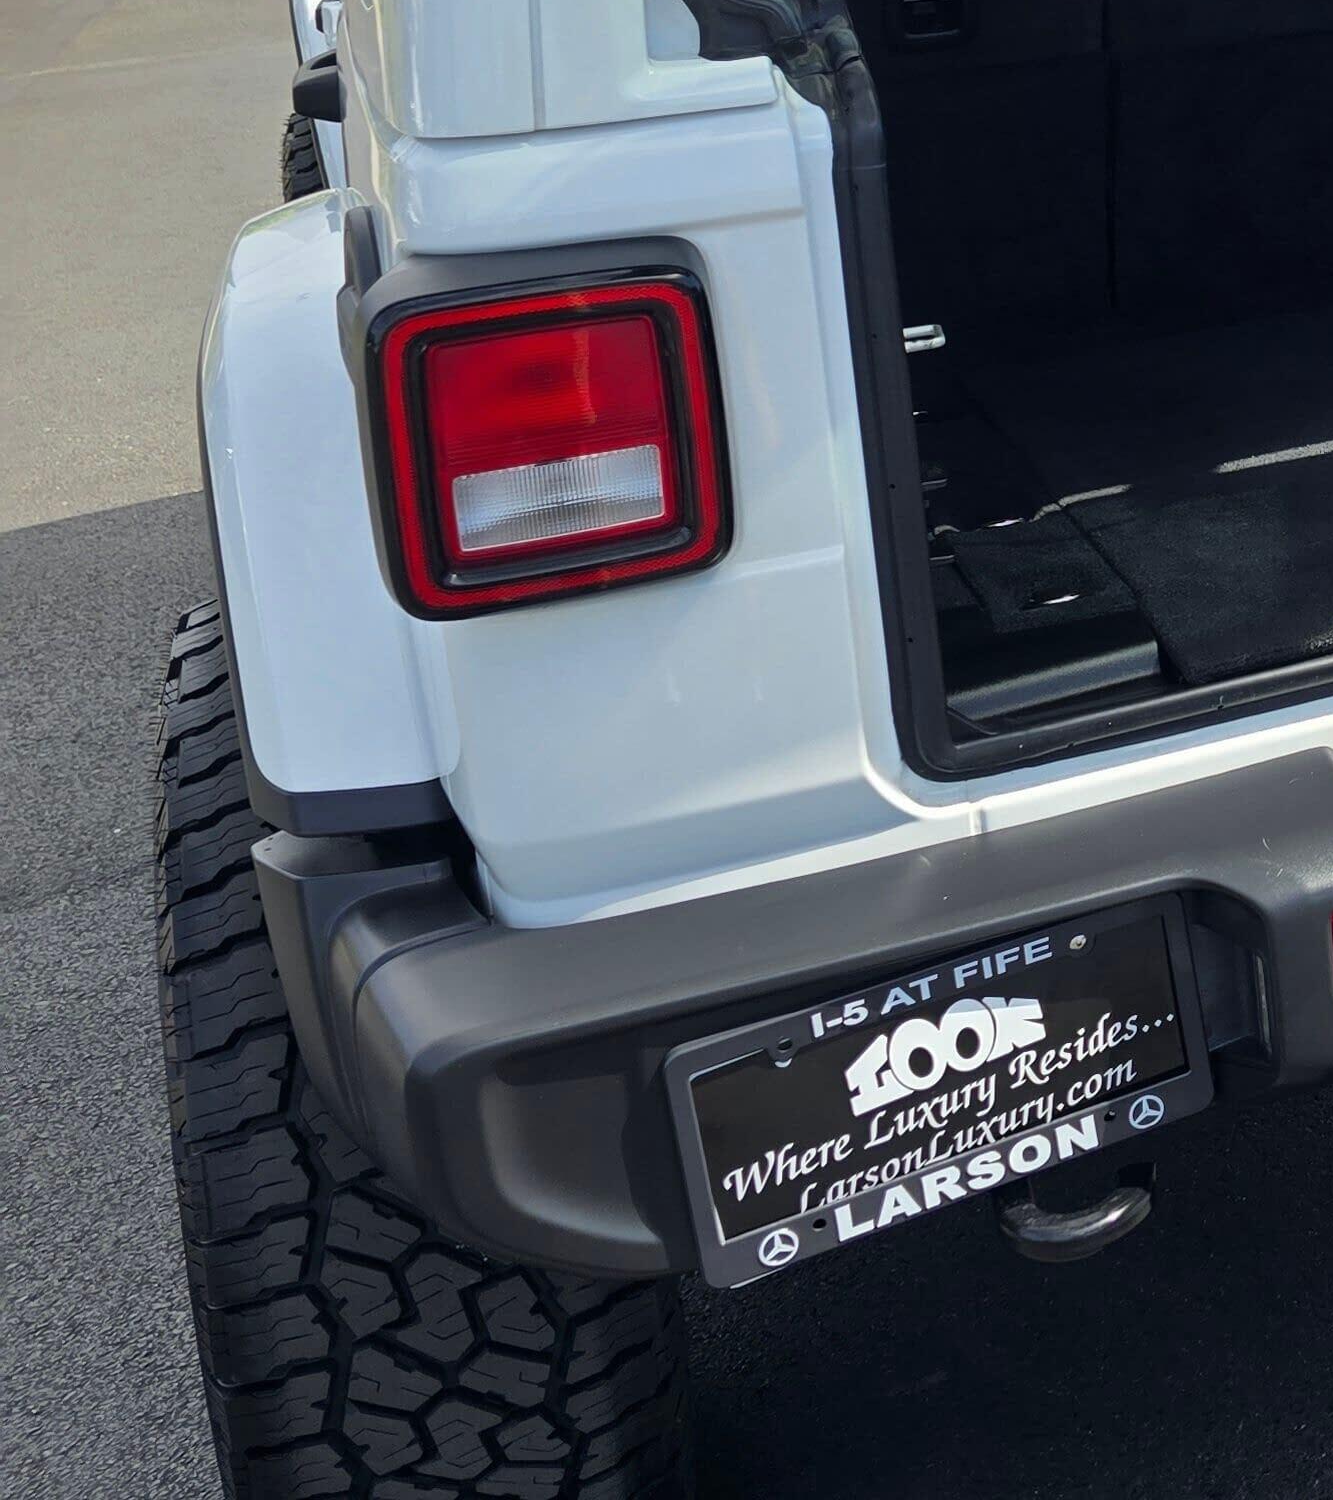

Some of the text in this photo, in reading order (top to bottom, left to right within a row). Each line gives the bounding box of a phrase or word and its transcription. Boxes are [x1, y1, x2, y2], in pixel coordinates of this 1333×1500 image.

[810, 935, 1054, 1040] I-5 AT FIFE
[721, 1010, 1176, 1204] Where Luxury Resides...
[798, 1052, 1138, 1214] LarsonLuxury.com
[832, 1113, 1101, 1243] LARSON
